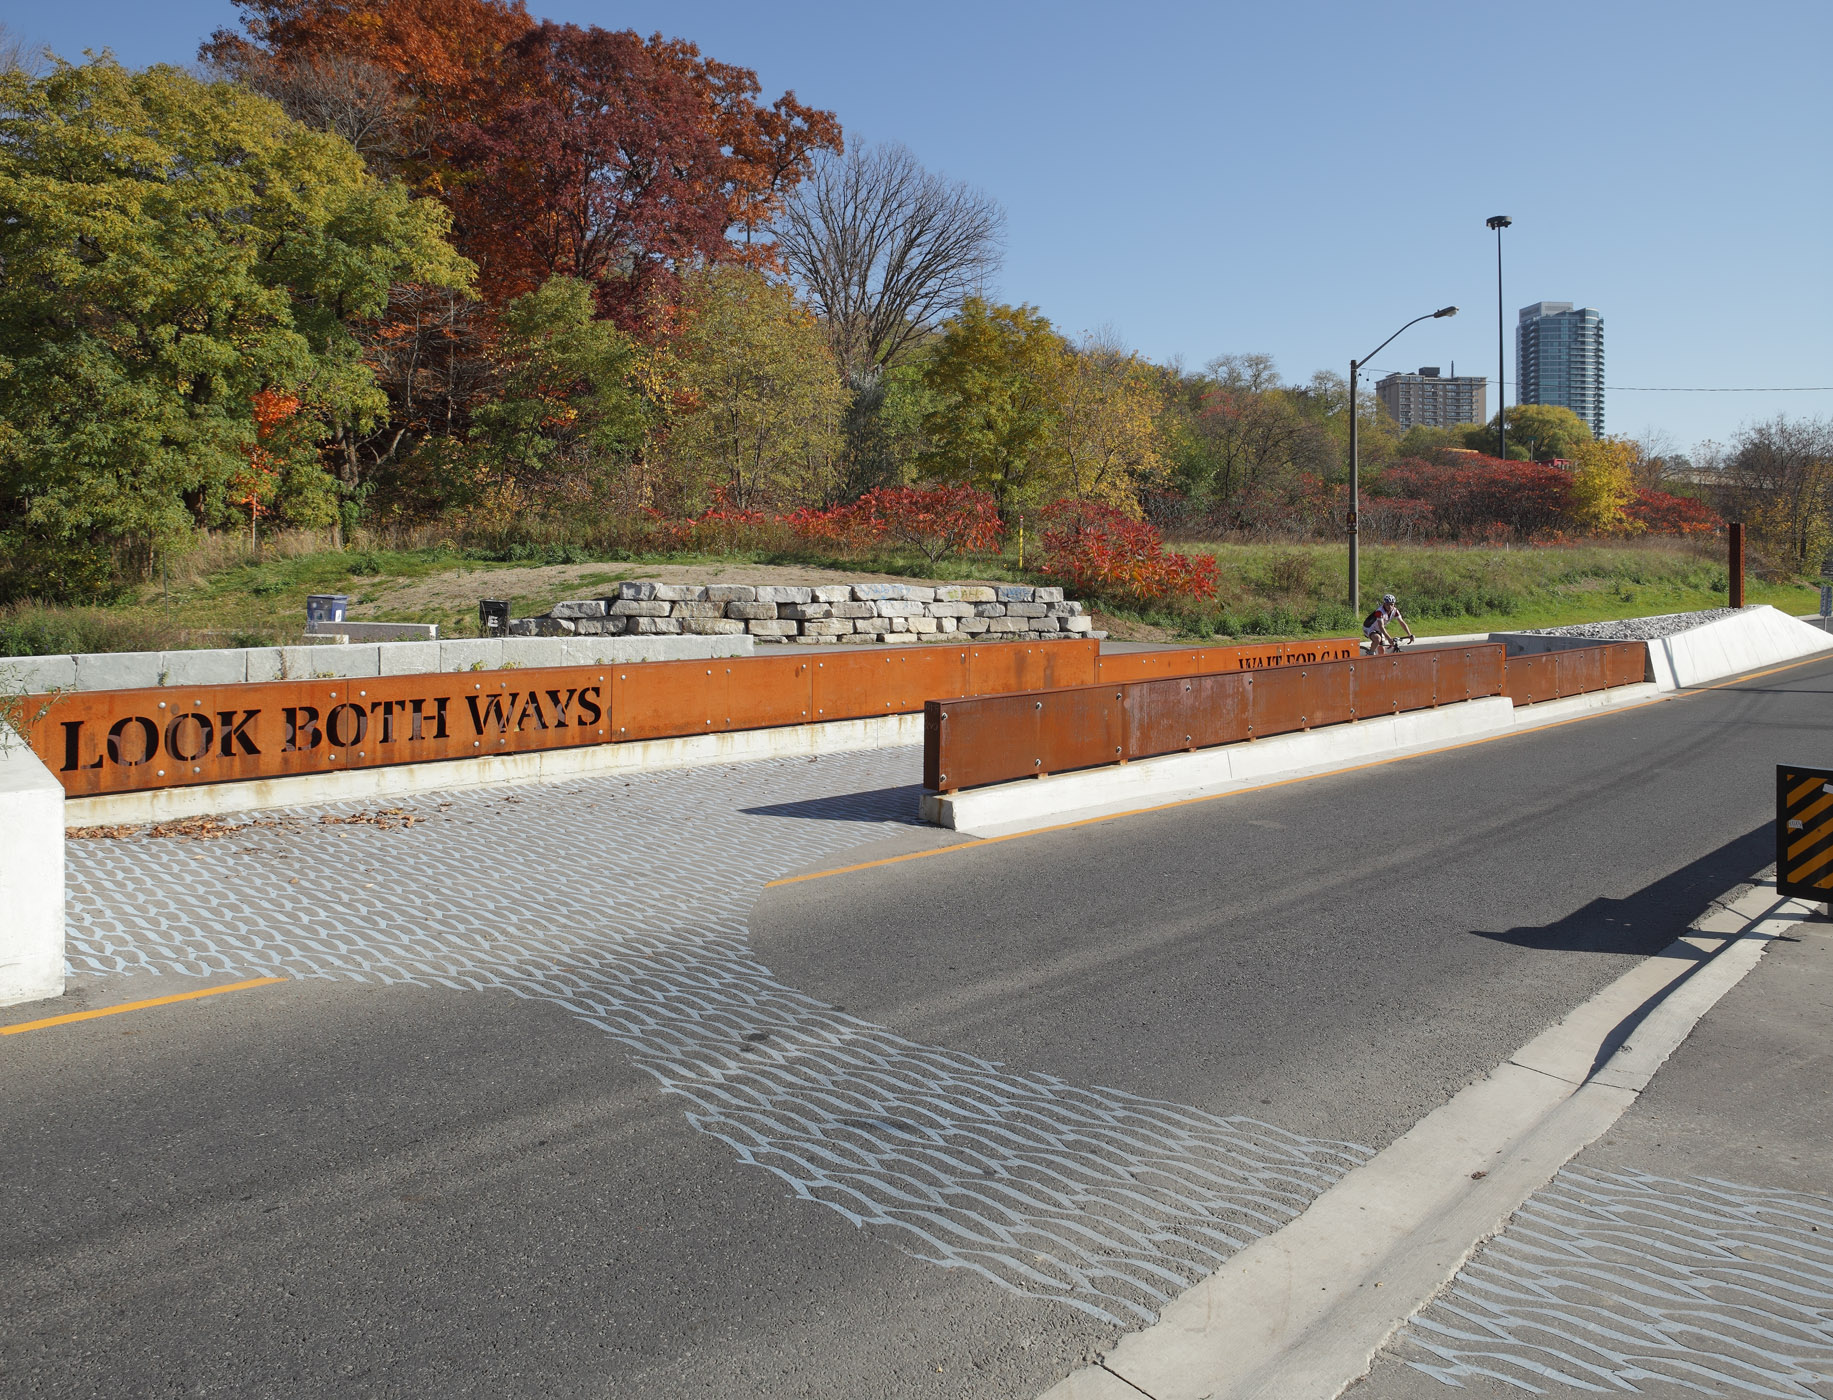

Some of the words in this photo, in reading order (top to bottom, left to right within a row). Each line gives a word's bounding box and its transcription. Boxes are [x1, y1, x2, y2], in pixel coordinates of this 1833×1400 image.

[1238, 655, 1282, 669] WAIT
[59, 708, 263, 773] LOOK
[280, 696, 451, 753] BOTH
[464, 686, 602, 736] WAYS
